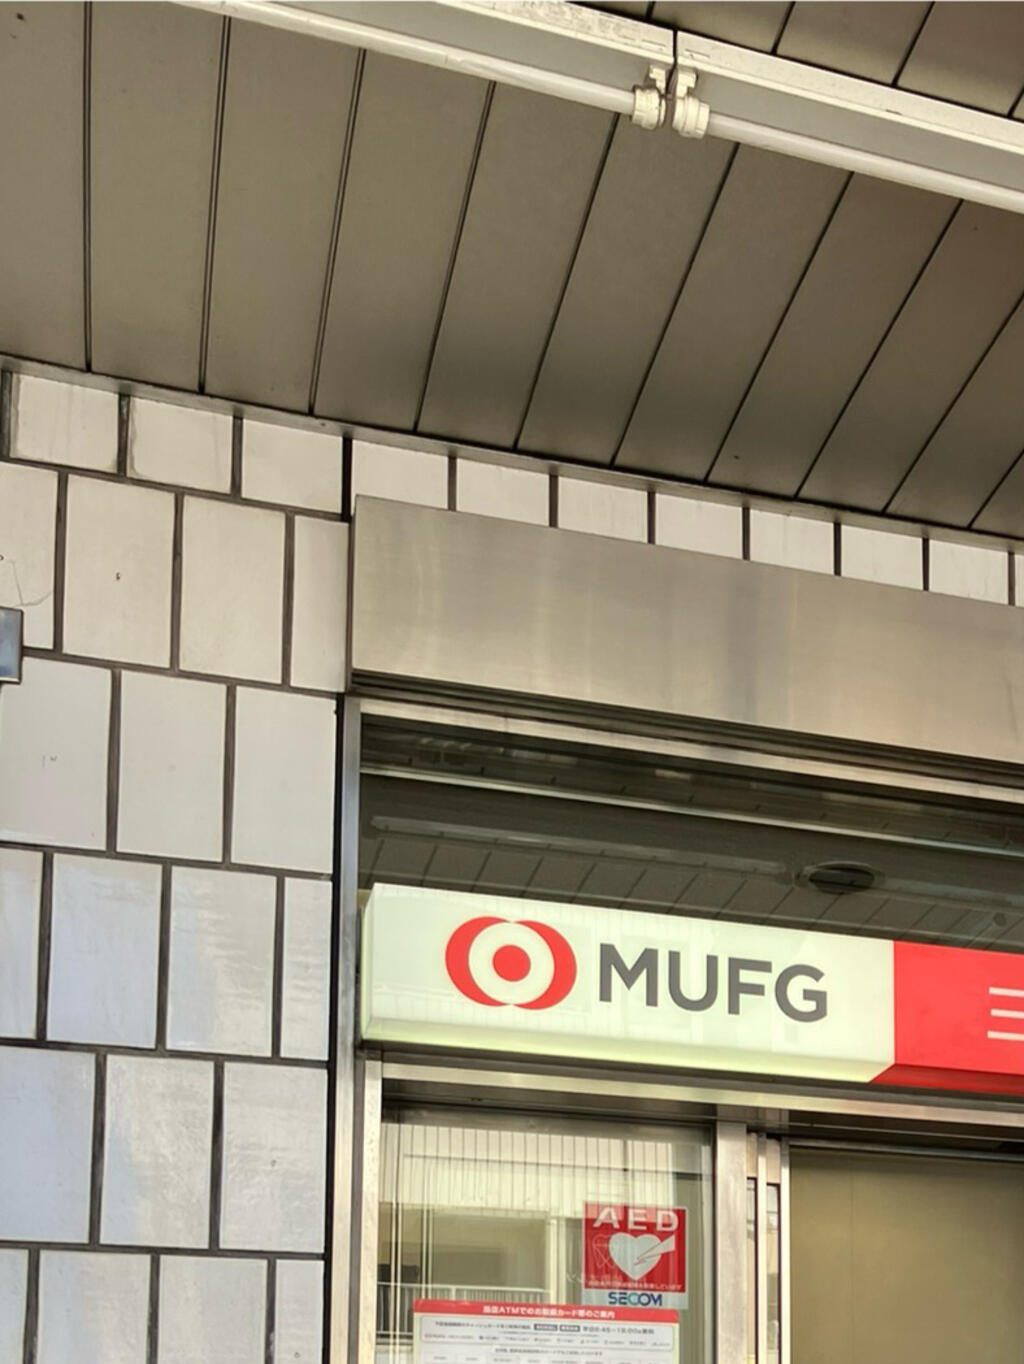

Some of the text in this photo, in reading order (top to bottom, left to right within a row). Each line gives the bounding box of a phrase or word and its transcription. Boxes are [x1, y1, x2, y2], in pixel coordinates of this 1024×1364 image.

[600, 943, 828, 1023] MUFG
[592, 1207, 679, 1232] AED
[608, 1291, 662, 1306] SECOM
